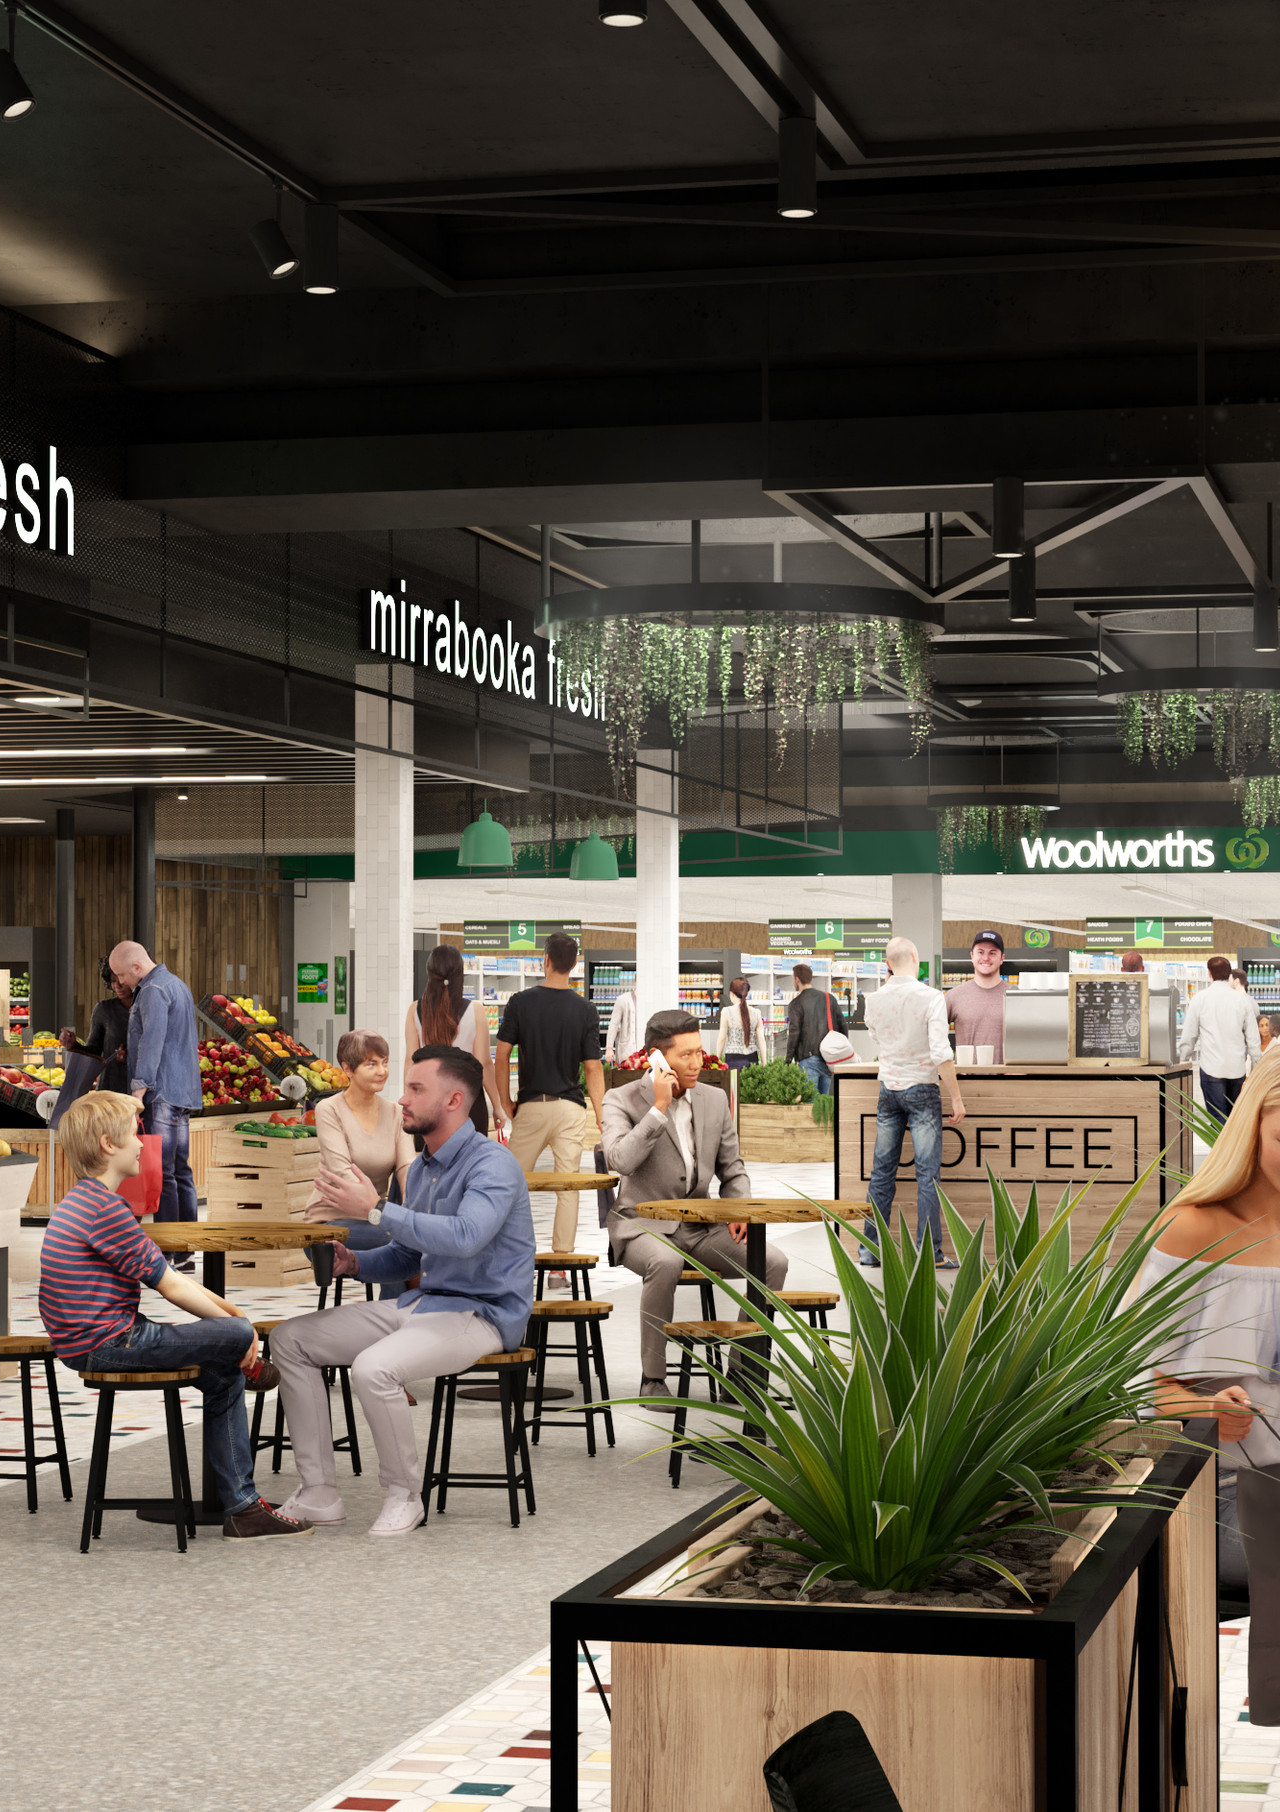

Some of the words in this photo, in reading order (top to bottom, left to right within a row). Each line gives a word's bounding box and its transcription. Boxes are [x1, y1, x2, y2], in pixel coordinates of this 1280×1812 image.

[370, 579, 536, 700] mirrabooka
[1020, 829, 1215, 869] Woolworths
[517, 922, 527, 936] 5
[824, 921, 835, 934] 6
[1145, 920, 1154, 933] 7
[898, 1125, 1113, 1169] OFFEE
